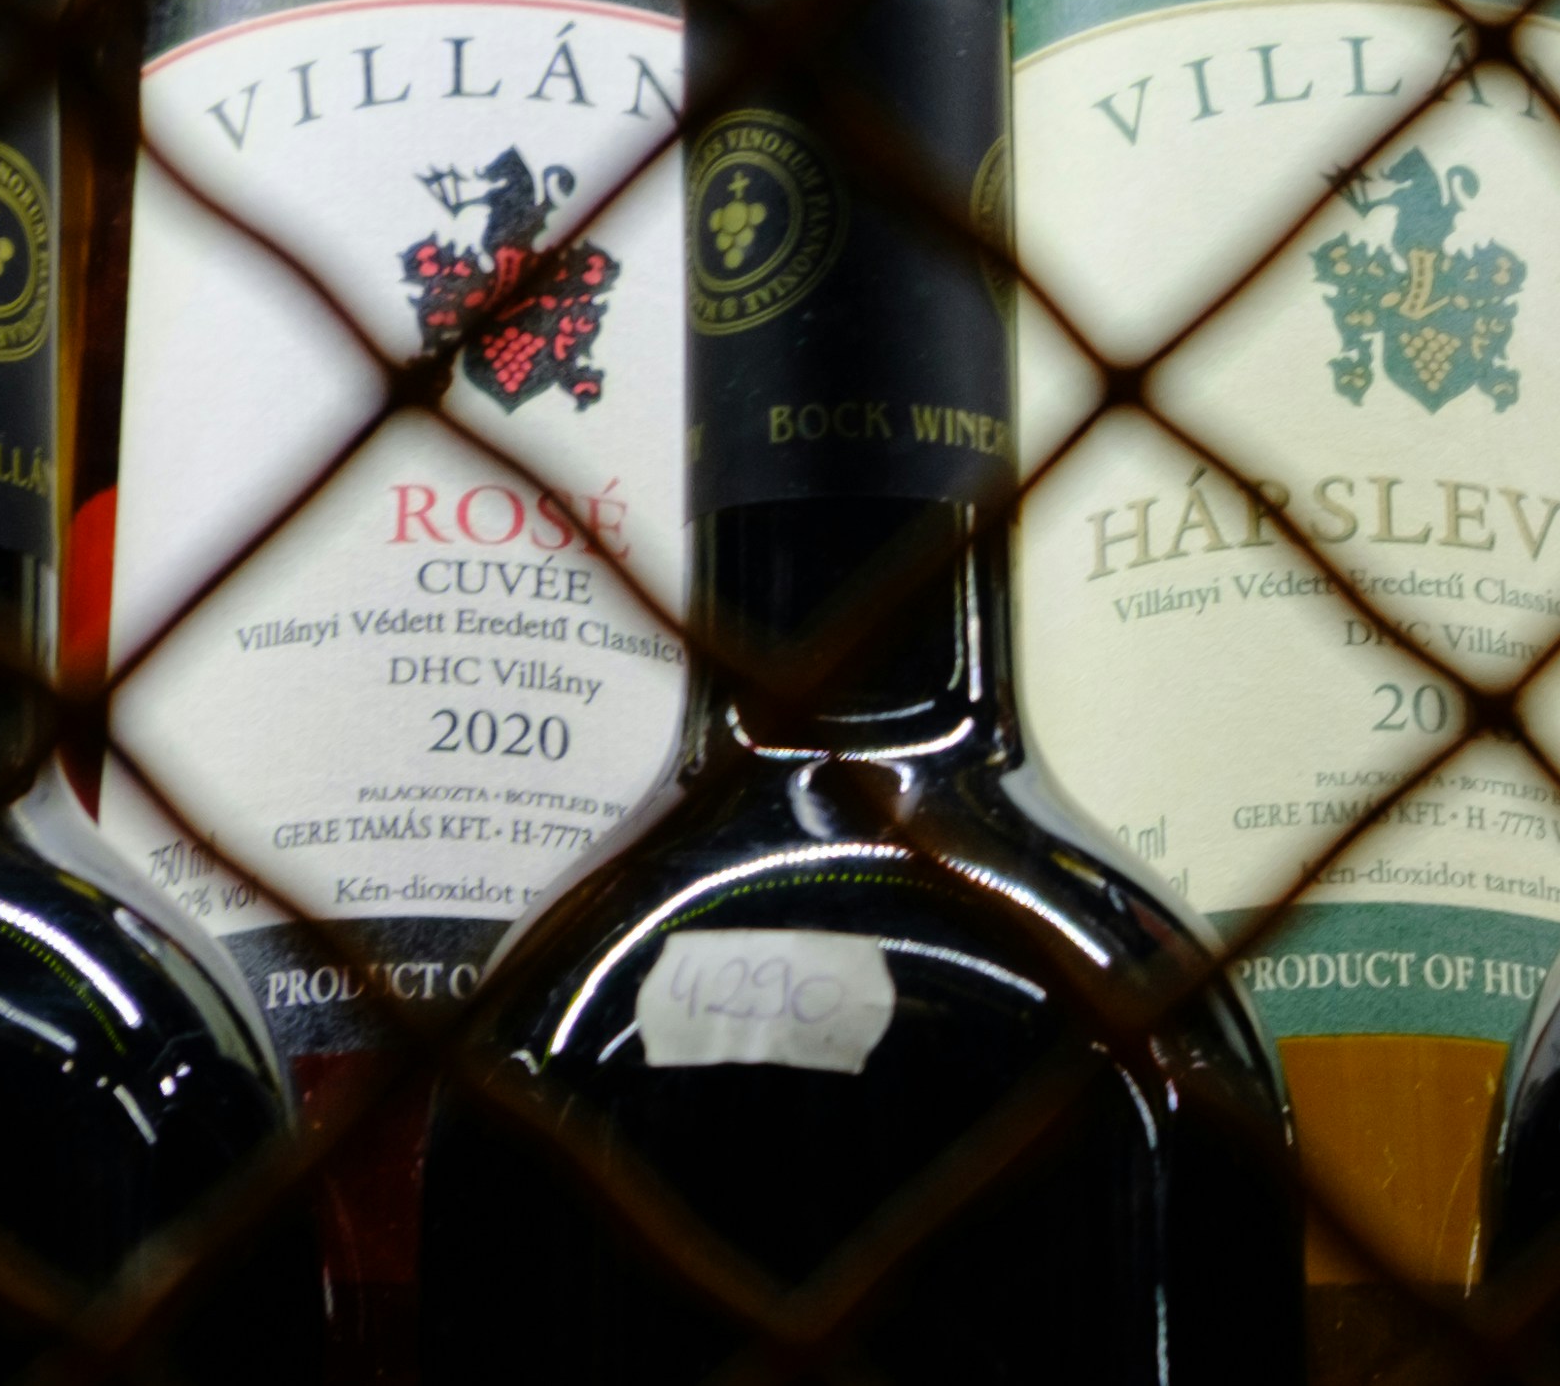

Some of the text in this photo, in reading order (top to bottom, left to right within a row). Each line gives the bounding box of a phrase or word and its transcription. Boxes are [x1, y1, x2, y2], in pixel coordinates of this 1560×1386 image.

[768, 403, 894, 445] BOCK
[388, 476, 633, 563] ROSÉ
[416, 557, 594, 607] CUVÉE
[1114, 580, 1222, 625] Villányi
[237, 615, 340, 655] Villányi
[351, 608, 446, 637] Védett
[454, 606, 568, 645] Eredetű
[388, 656, 604, 705] DHC Villány
[428, 709, 572, 763] 2020
[272, 820, 341, 851] GERE
[344, 808, 434, 842] TAMÁS
[334, 878, 516, 910] Kén-dioxidot
[1423, 954, 1476, 992] OF
